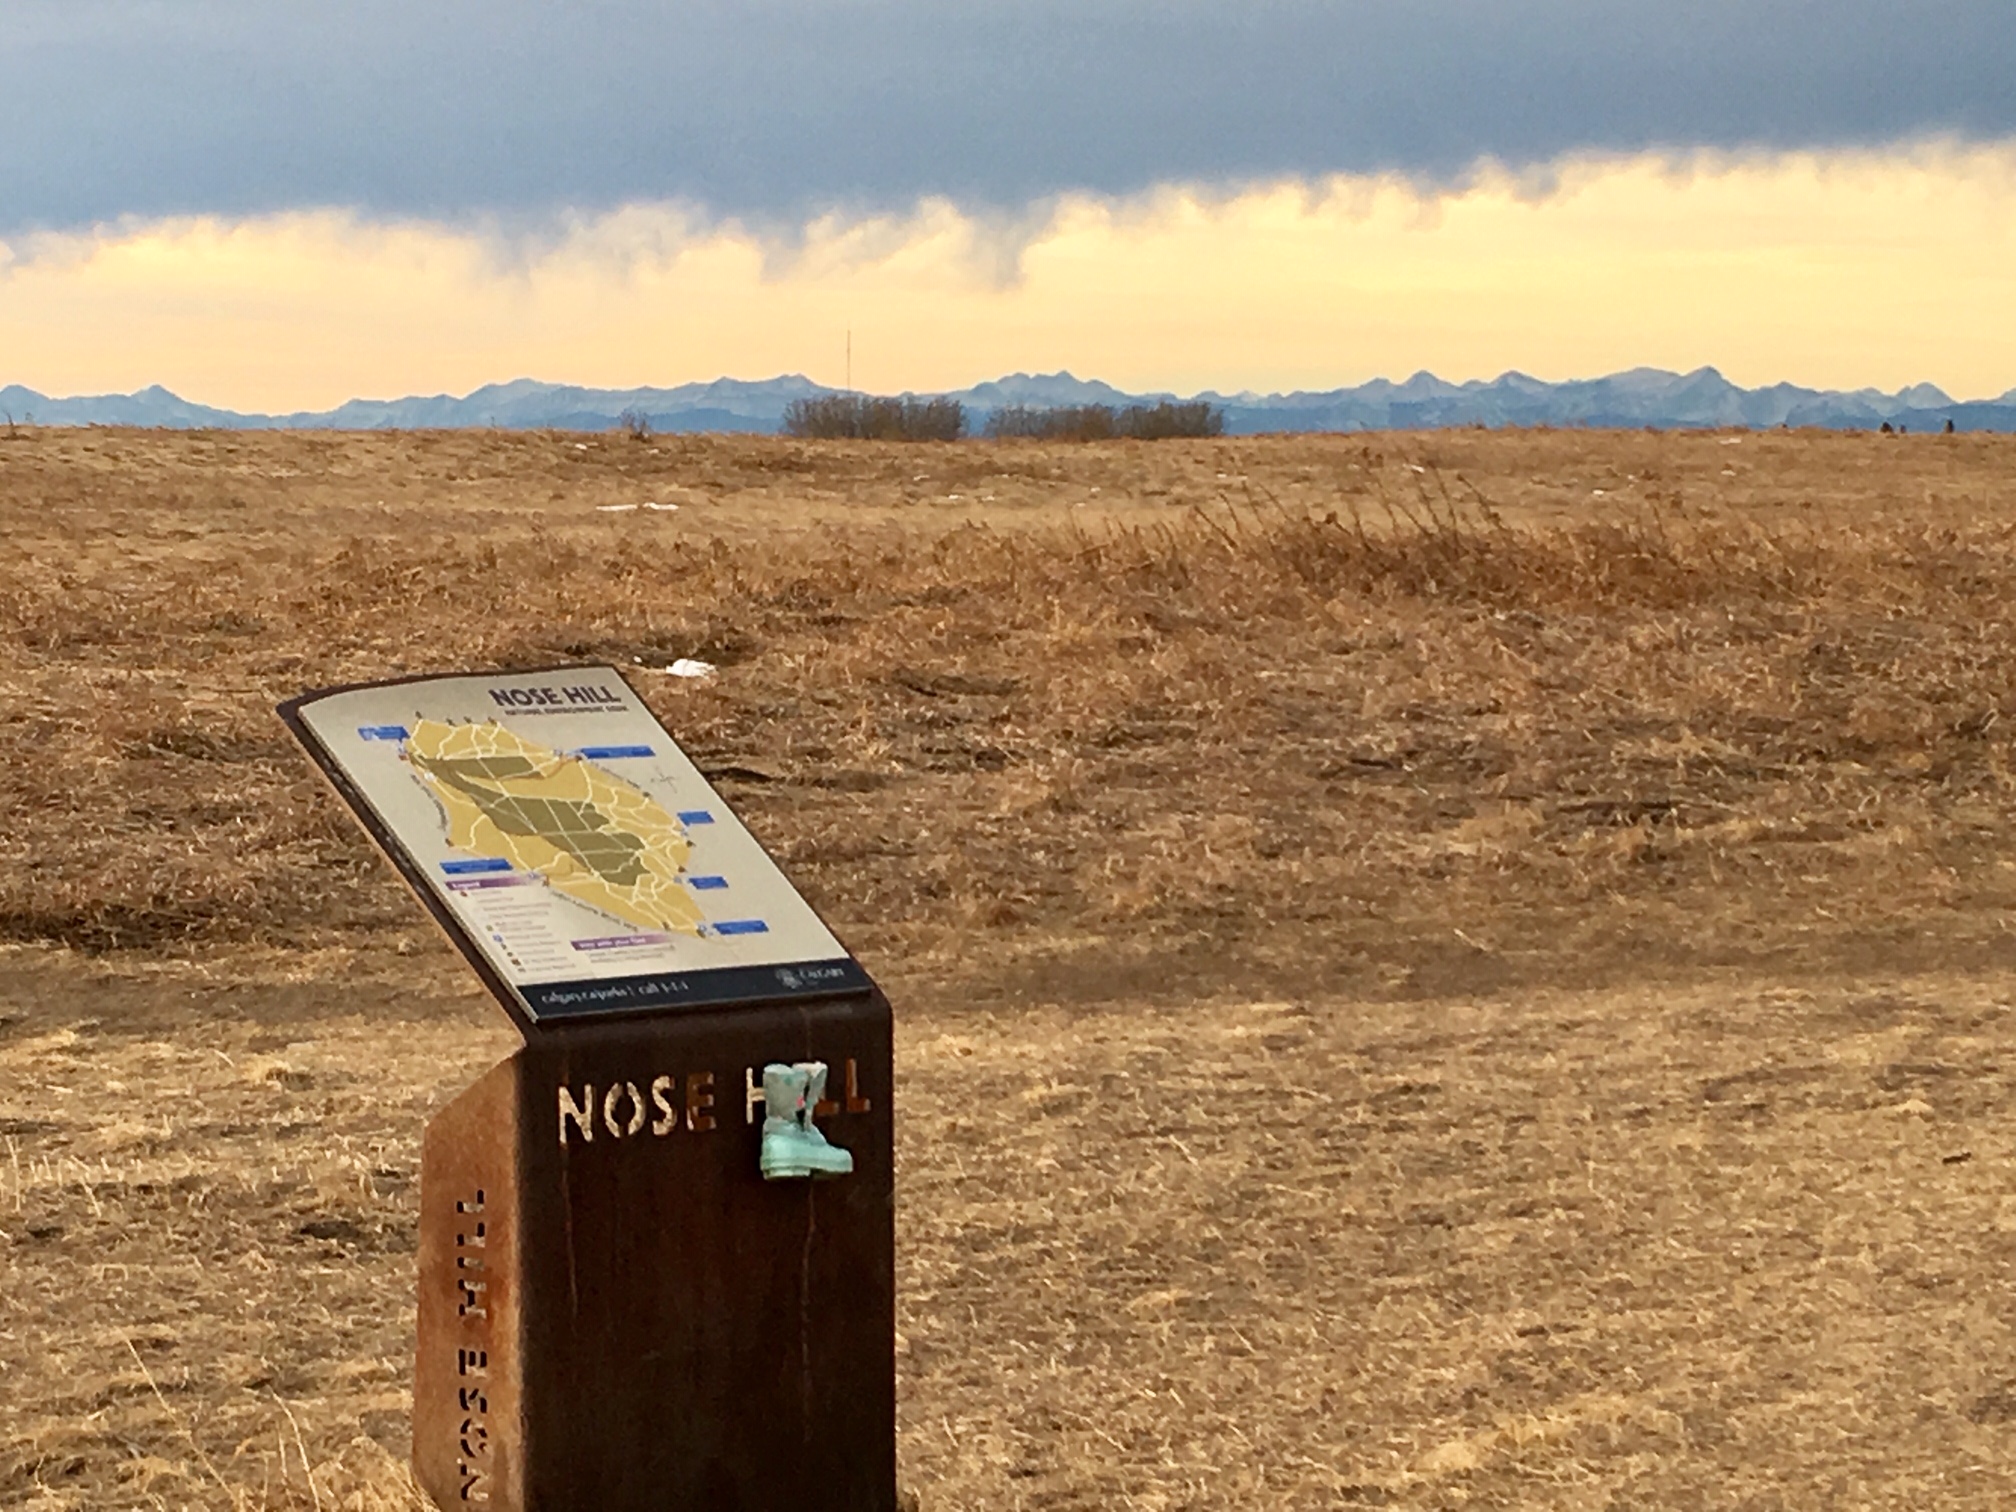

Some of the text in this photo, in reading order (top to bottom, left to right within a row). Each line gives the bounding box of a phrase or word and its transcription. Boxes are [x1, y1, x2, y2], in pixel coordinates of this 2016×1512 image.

[488, 685, 622, 707] NOSE HILL
[558, 1058, 872, 1145] NOSE HL
[456, 1189, 489, 1502] NOSE HILL
